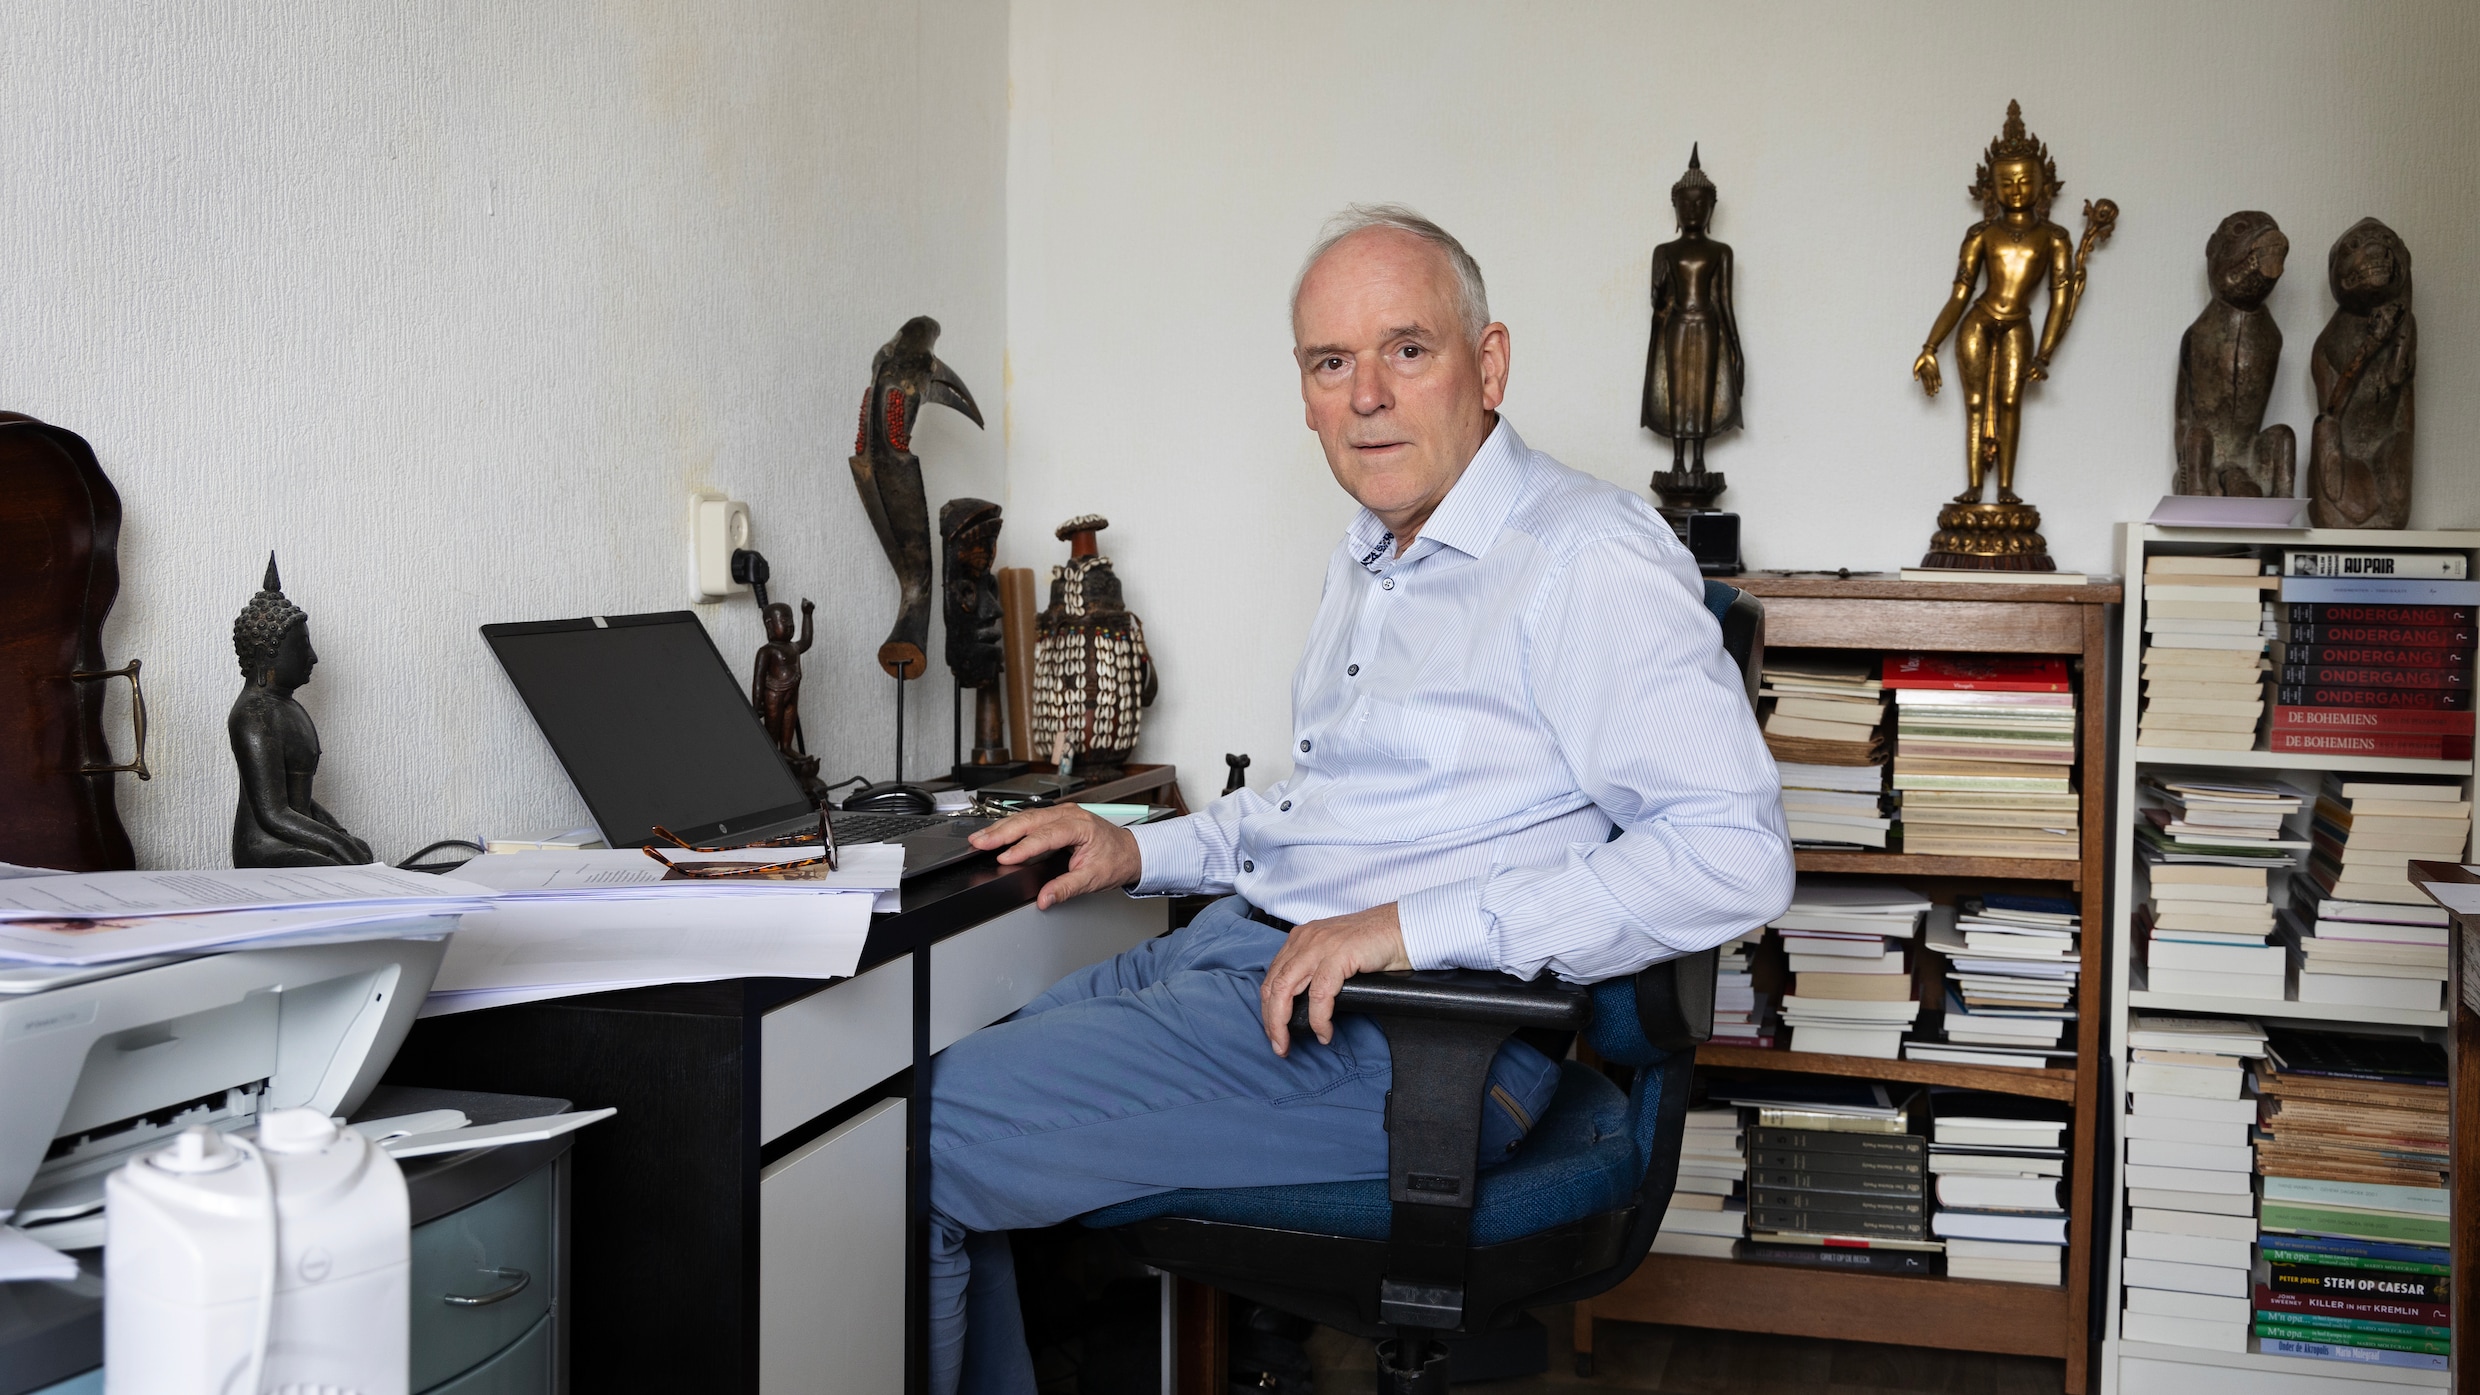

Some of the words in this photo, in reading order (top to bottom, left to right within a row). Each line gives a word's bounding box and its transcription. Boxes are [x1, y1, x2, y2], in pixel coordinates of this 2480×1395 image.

[2344, 558, 2362, 573] AU
[2363, 558, 2394, 574] PAIR
[2326, 608, 2436, 622] ONDERGANG
[2328, 628, 2439, 643] ONDERGANG
[2322, 649, 2433, 664] ONDERGANG
[2320, 669, 2431, 684] ONDERGANG
[2315, 690, 2426, 705] ONDERGANG
[2288, 711, 2304, 723] DE
[2306, 712, 2377, 726] BOHEMIENS
[2285, 735, 2301, 747] DE
[2304, 736, 2375, 750] BOHEMIENS
[2274, 1250, 2291, 1260] M'n
[2279, 1275, 2299, 1283] PETER
[2300, 1276, 2320, 1284] JONES
[2324, 1276, 2354, 1289] STEM
[2358, 1279, 2375, 1291] OP
[2378, 1281, 2425, 1295] CAESAR
[2270, 1298, 2302, 1306] SWEENEY
[2309, 1298, 2344, 1309] KILLER
[2356, 1304, 2371, 1312] HET
[2373, 1304, 2419, 1316] KREMLIN
[2267, 1312, 2285, 1321] M'n
[2267, 1327, 2285, 1336] M'n
[2278, 1340, 2297, 1351] Onder
[2298, 1342, 2303, 1351] de
[2304, 1343, 2329, 1356] Akropolis
[2335, 1347, 2350, 1358] Mario
[2352, 1348, 2380, 1361] Molegraaf
